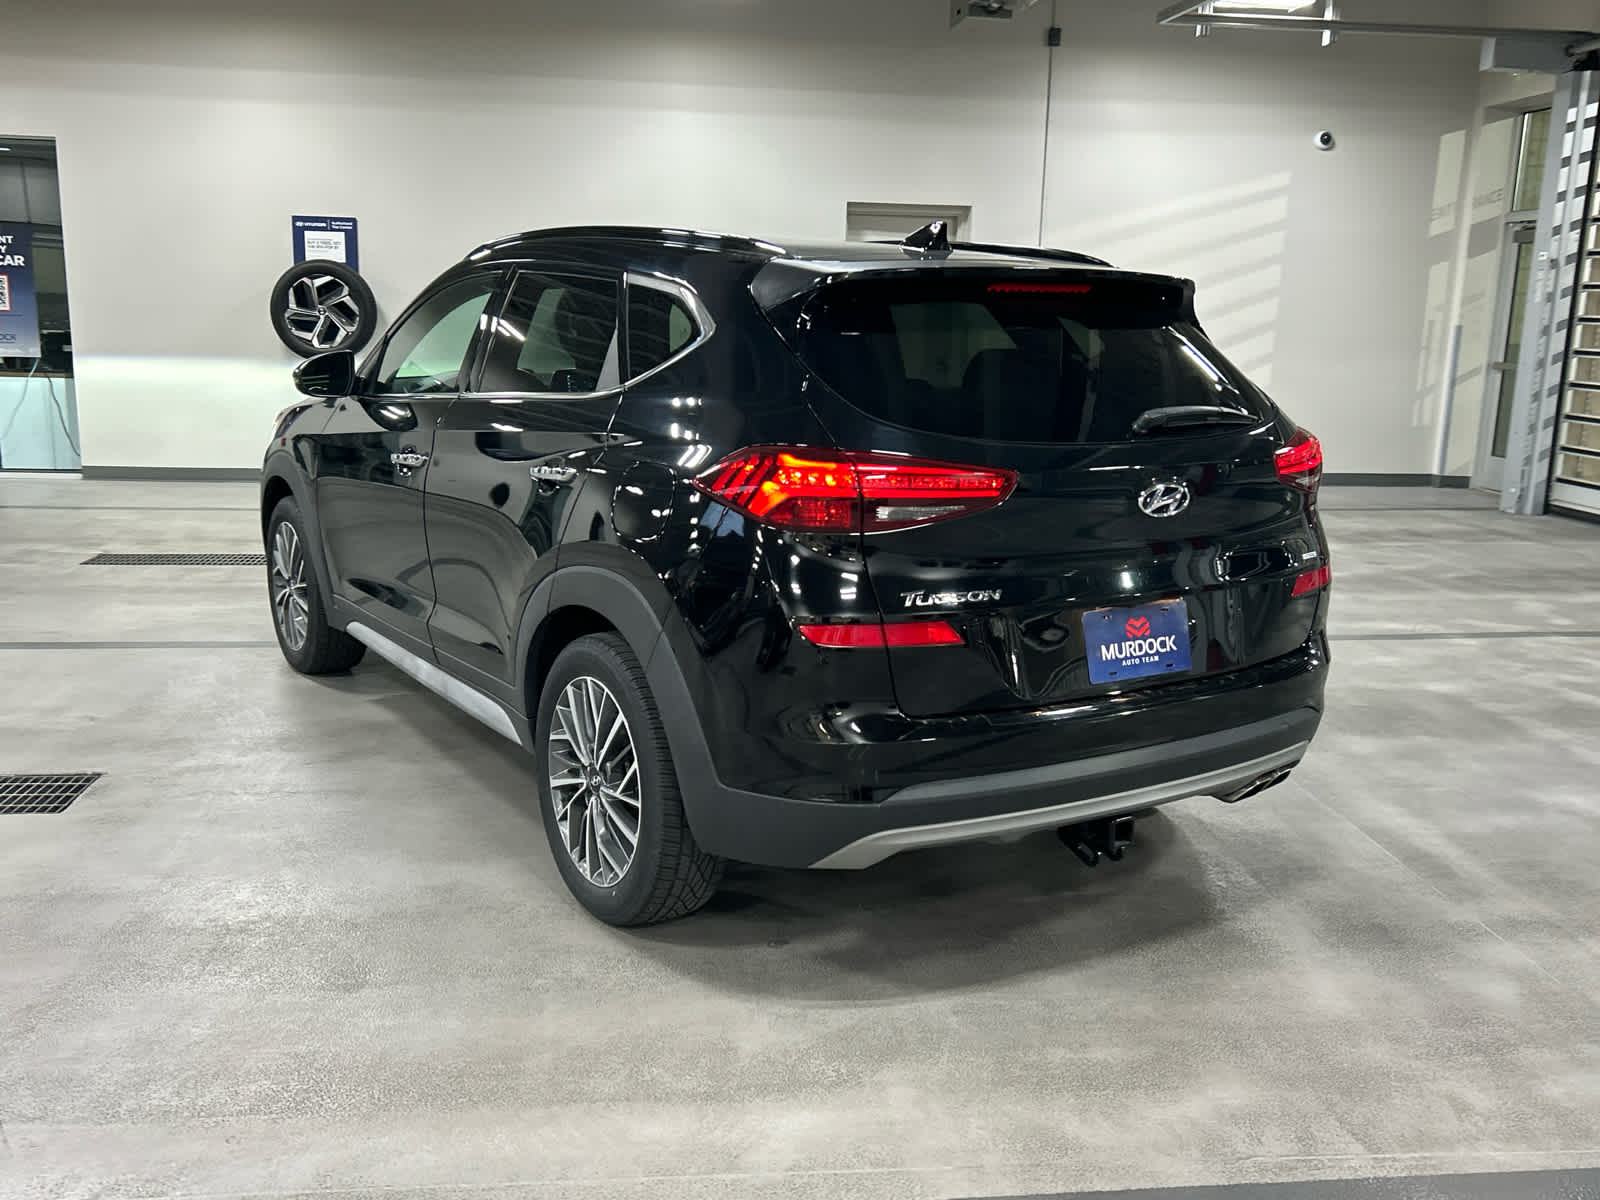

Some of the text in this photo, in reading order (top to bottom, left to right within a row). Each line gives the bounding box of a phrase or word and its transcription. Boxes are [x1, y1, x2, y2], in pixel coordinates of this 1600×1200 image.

[900, 589, 1002, 607] TUCSON
[1101, 635, 1178, 661] MURDOCK
[1122, 655, 1159, 666] AUTO TEAM
